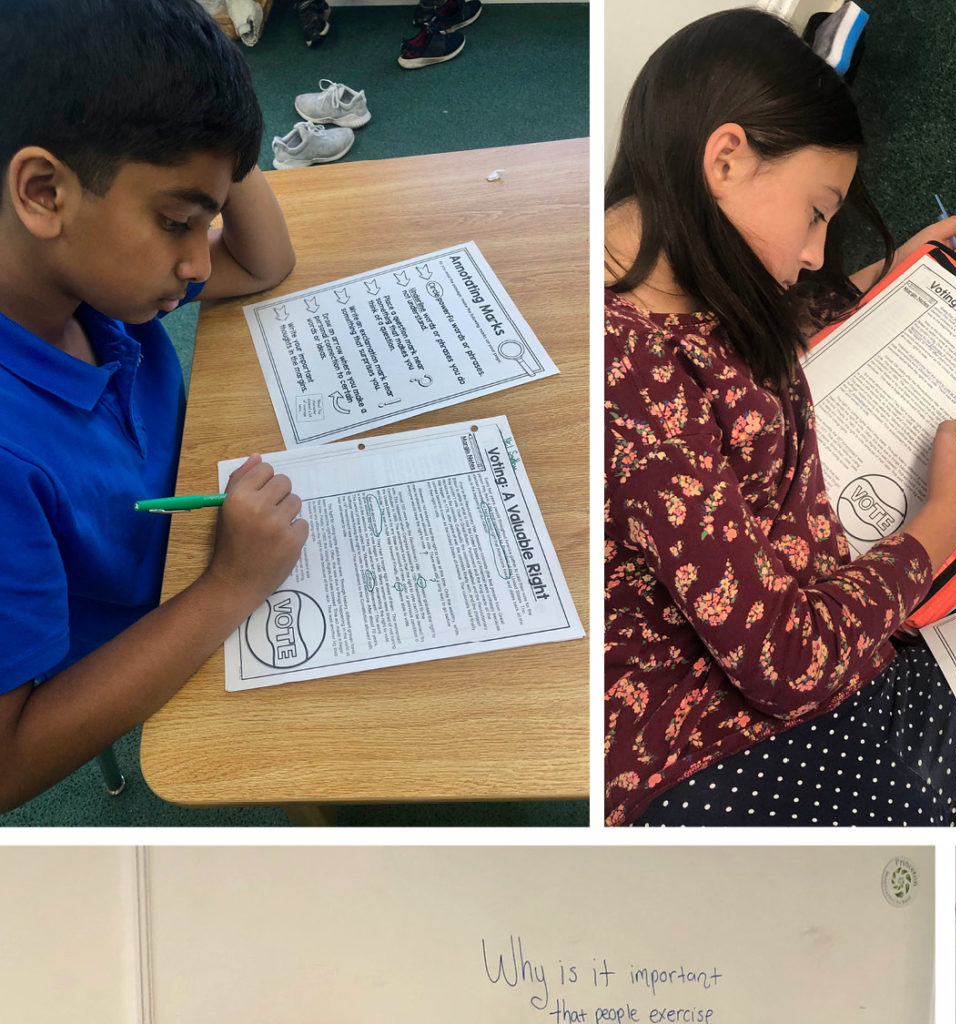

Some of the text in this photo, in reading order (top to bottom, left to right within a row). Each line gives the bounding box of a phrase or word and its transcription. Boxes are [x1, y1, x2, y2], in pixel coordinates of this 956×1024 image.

[450, 255, 505, 337] Annotating Marks
[435, 338, 466, 385] phrases you do
[488, 446, 509, 488] Voting:
[502, 492, 516, 502] A
[850, 485, 895, 532] VOTE
[507, 504, 534, 560] Valuable
[526, 563, 550, 600] Right
[273, 597, 297, 661] VOTE
[481, 935, 723, 1011] Why is it important
[549, 998, 588, 1024] that
